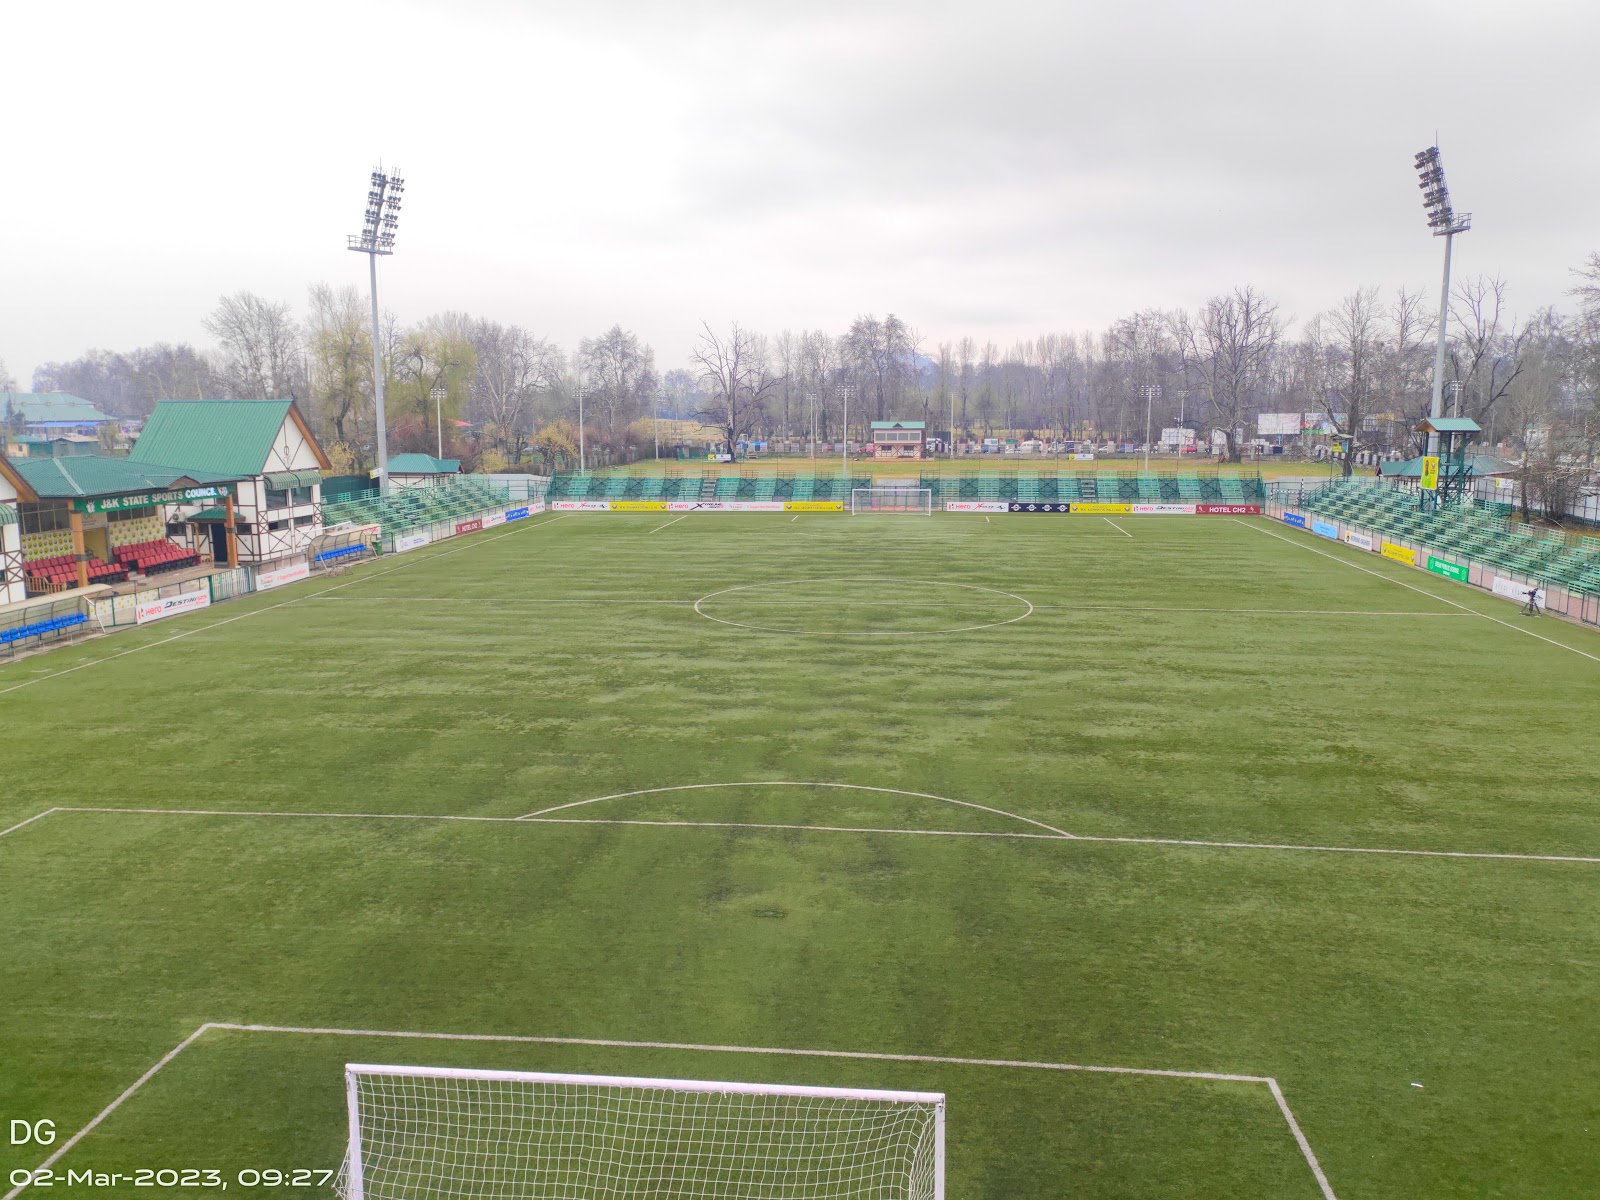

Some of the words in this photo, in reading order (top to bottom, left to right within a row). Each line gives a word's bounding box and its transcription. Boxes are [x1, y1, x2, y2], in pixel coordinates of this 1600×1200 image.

[101, 498, 119, 509] J&K
[123, 495, 149, 507] STATE
[151, 491, 183, 503] SPORTS
[145, 605, 162, 616] Hero
